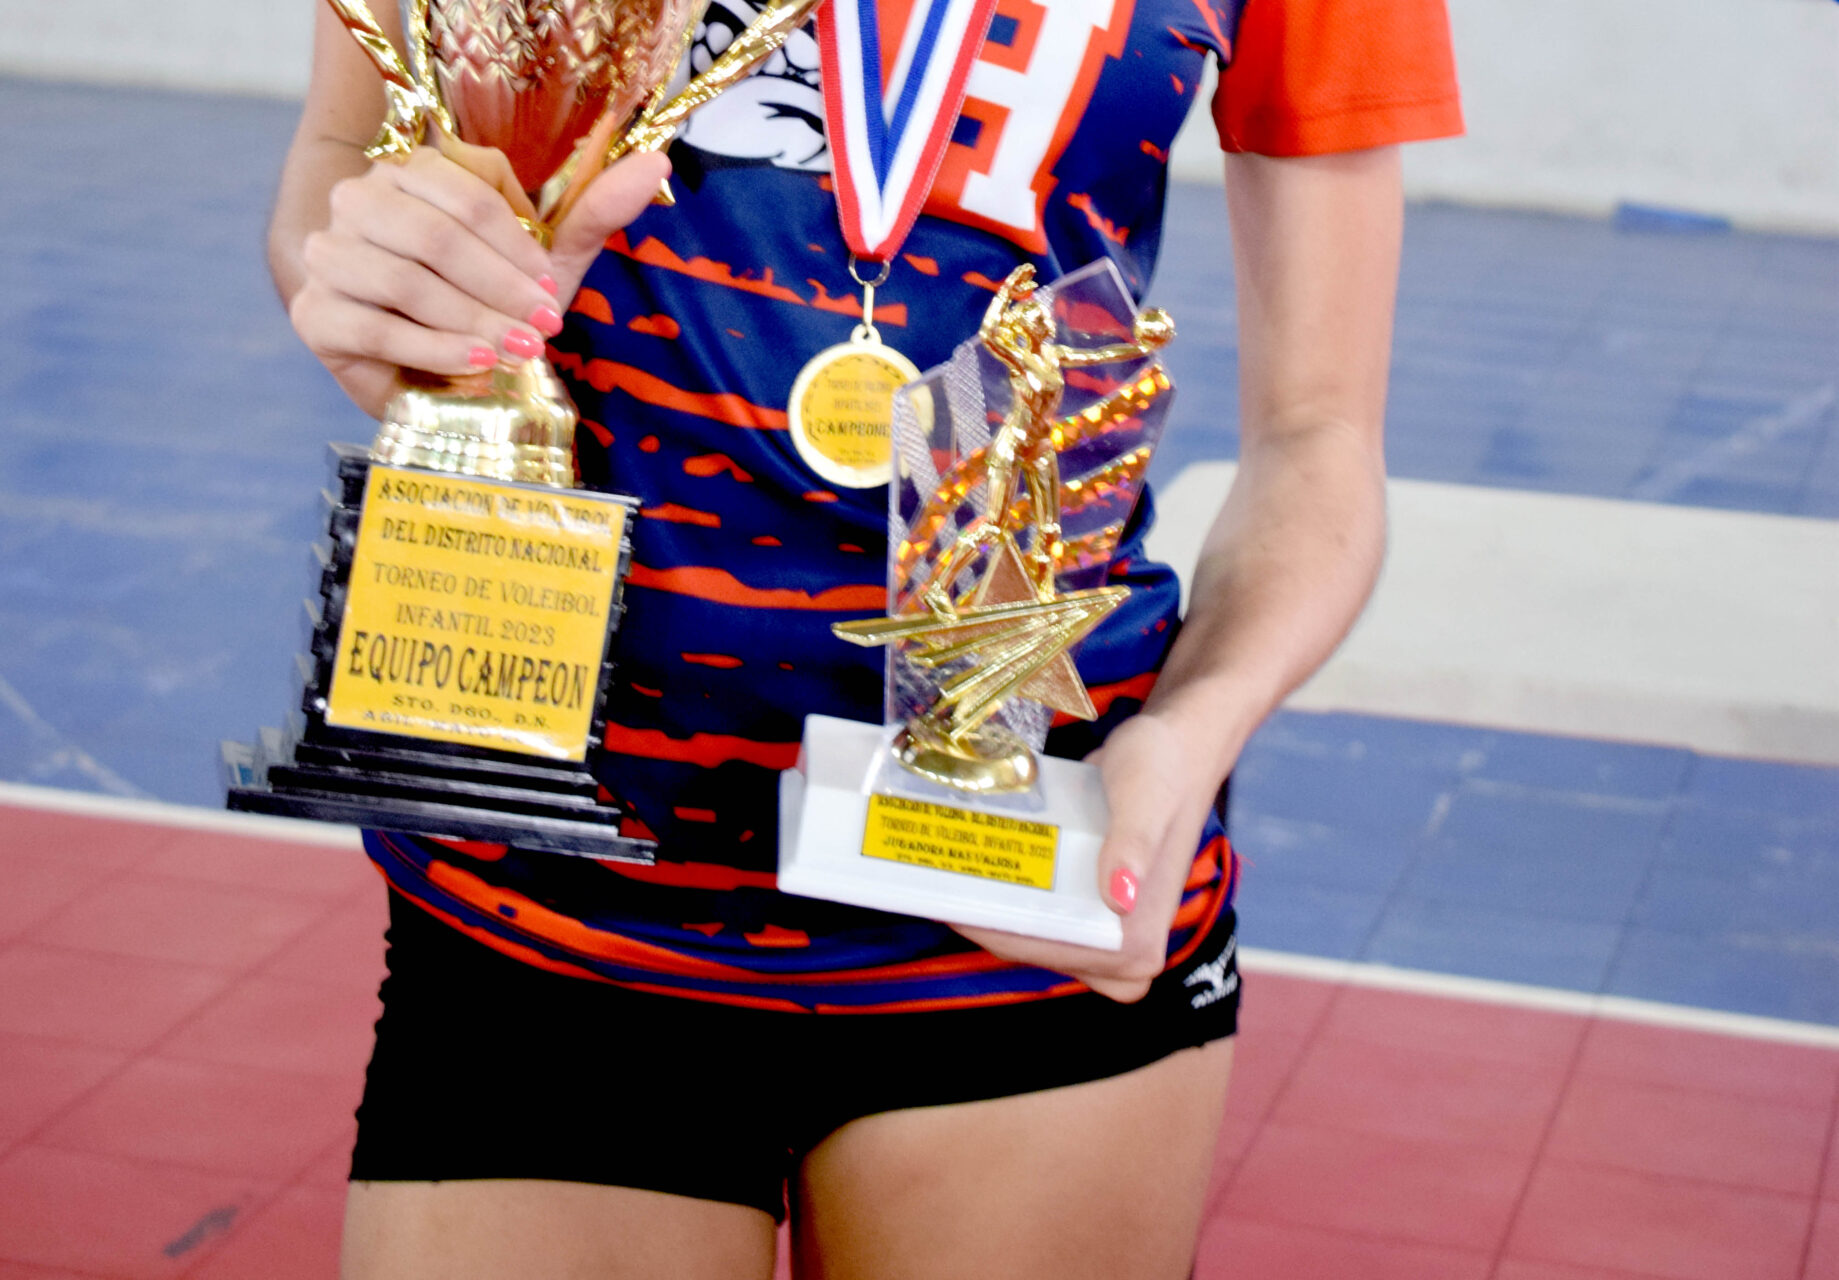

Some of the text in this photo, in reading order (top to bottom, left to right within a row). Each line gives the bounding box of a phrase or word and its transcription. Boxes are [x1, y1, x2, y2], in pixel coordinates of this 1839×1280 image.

[382, 517, 602, 572] DEL DISTRITO NACIONAL
[374, 562, 600, 616] TORNEO DE VOLEIBOL
[396, 603, 556, 647] INFANTIL 2023
[349, 630, 589, 711] EQUIPO CAMPEON
[392, 694, 439, 711] STO.
